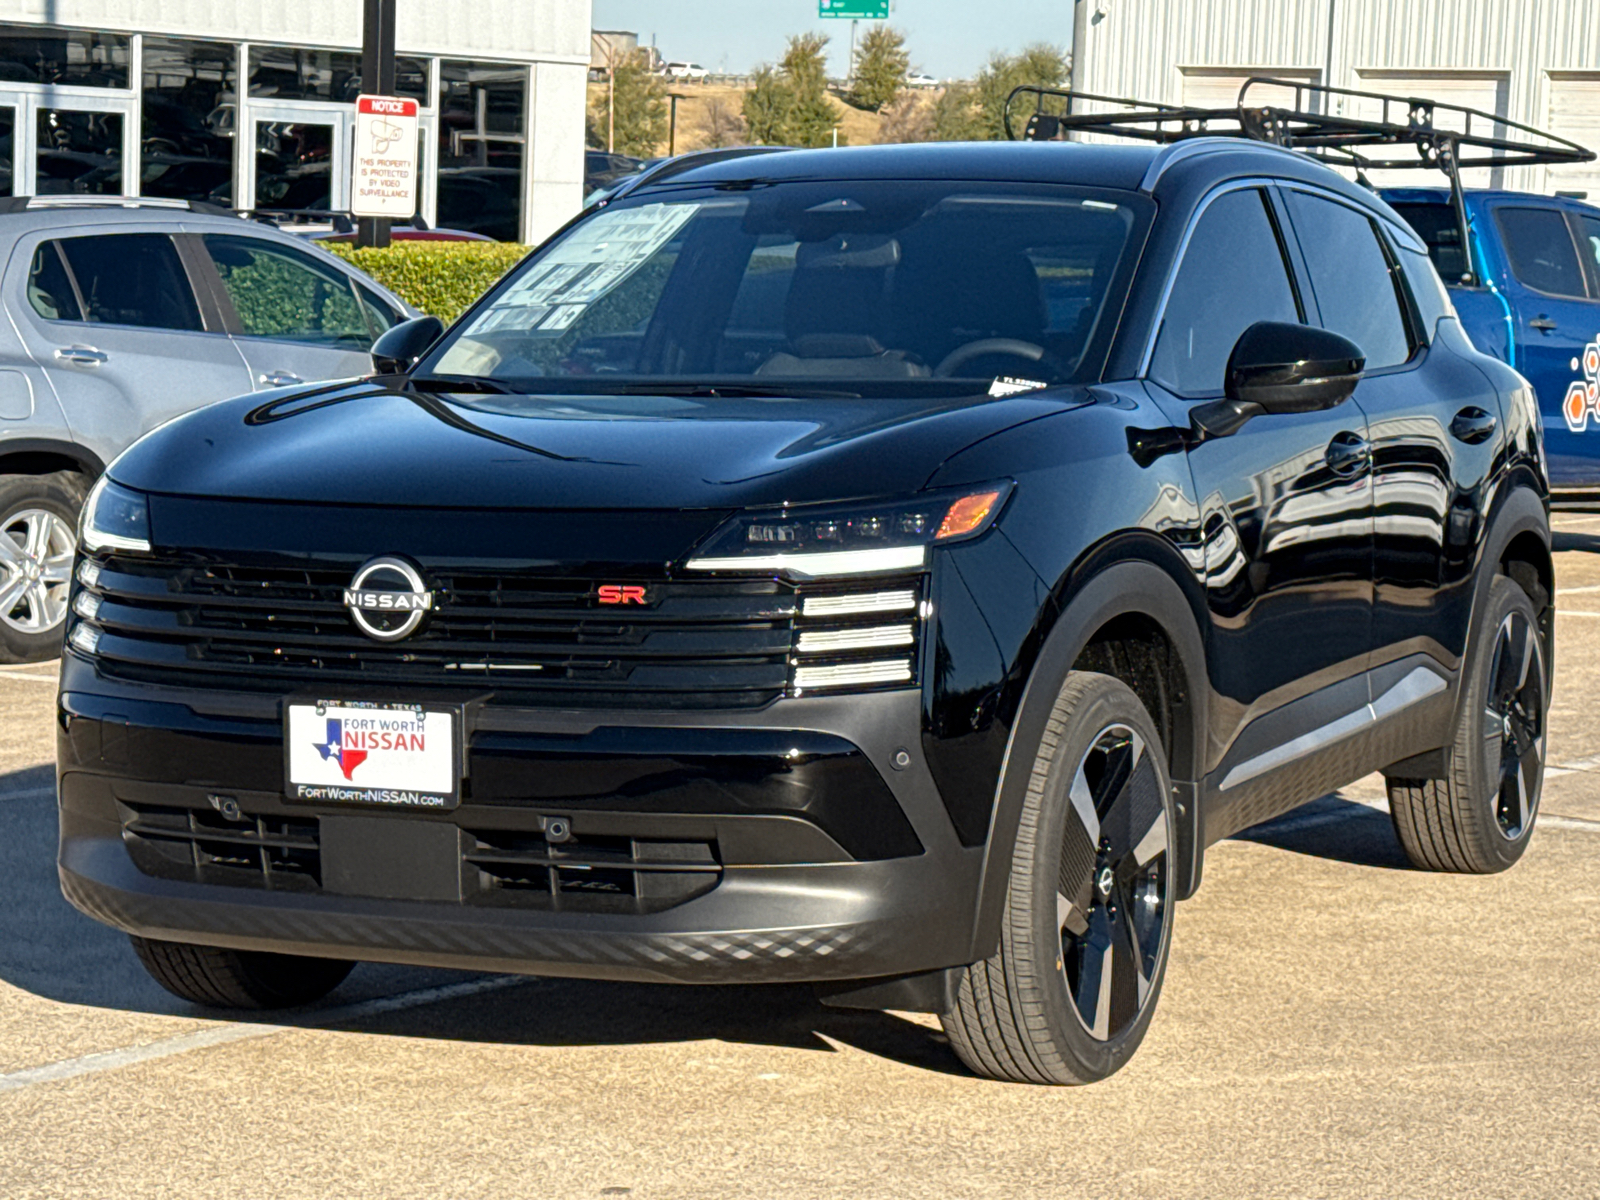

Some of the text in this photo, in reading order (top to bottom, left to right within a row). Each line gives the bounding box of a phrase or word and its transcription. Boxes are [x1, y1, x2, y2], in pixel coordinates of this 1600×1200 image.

[371, 100, 404, 113] NOTICE
[360, 158, 411, 168] THIS PROPERTY
[361, 168, 409, 178] IS PROTECTED
[369, 179, 400, 188] BY VIDEO
[359, 188, 409, 198] SURVEILLANCE
[344, 591, 429, 608] NISSAN
[598, 585, 646, 604] SR
[317, 699, 422, 712] FORT WORTH TEXAS
[344, 718, 425, 732] FORT WORTH
[345, 731, 425, 751] NISSAN
